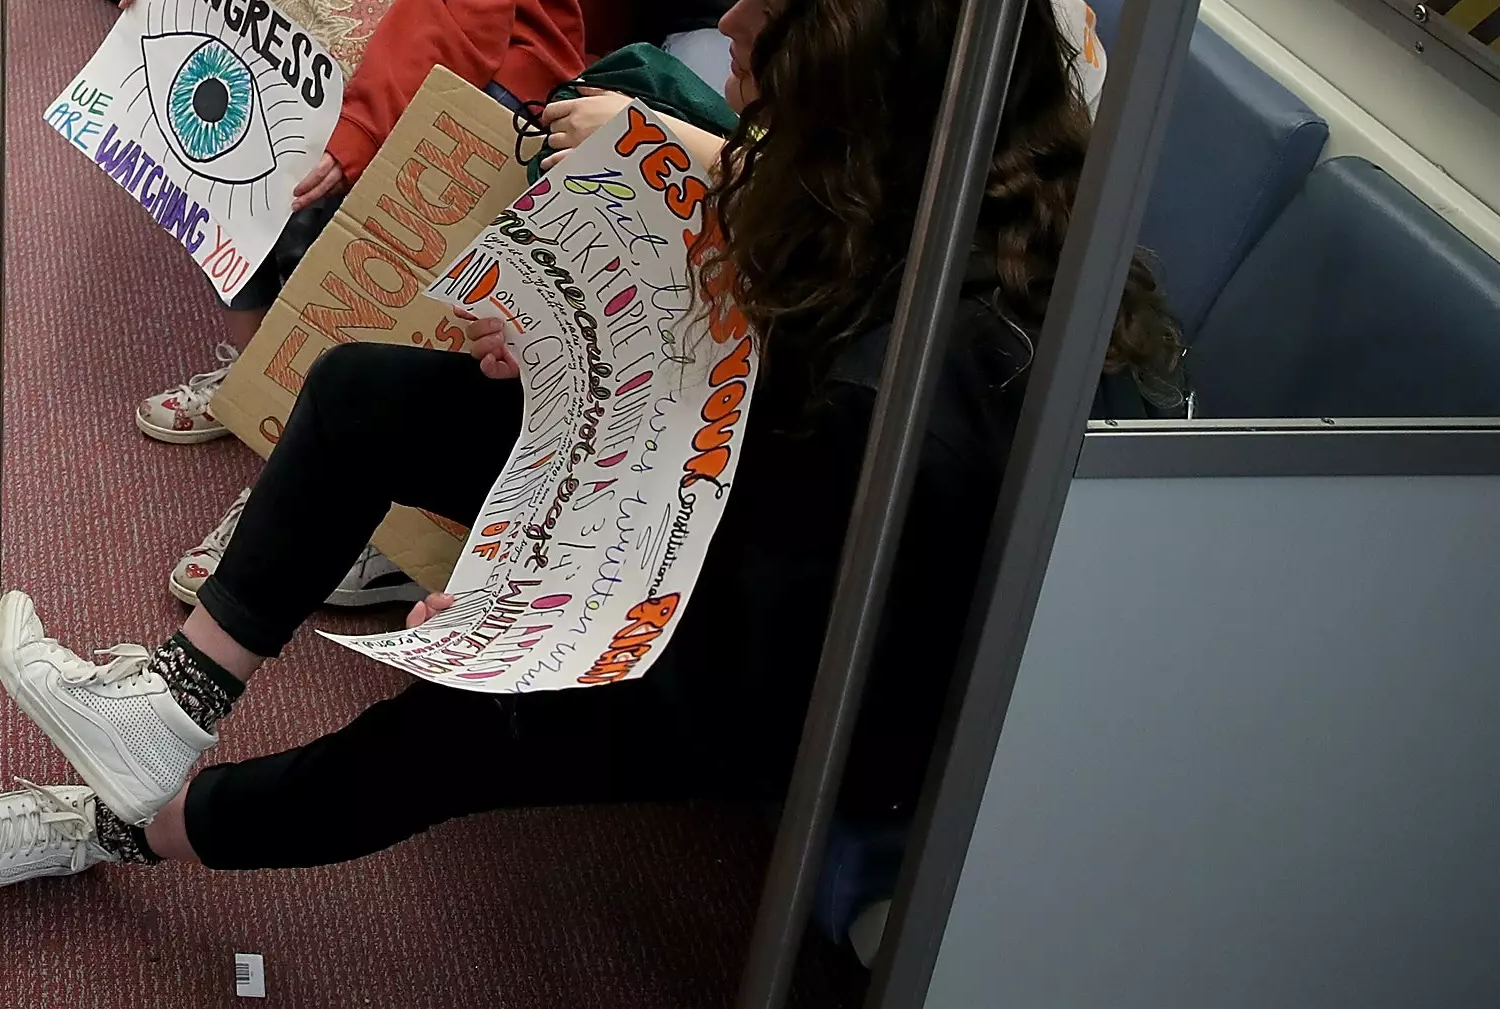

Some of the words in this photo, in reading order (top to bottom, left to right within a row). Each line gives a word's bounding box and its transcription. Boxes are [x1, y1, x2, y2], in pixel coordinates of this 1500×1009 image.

[71, 79, 114, 117] WE
[46, 103, 103, 150] ARE
[95, 123, 210, 255] WATCHING
[201, 224, 250, 294] YOU
[512, 177, 609, 274] BLACK
[264, 110, 509, 397] ENOUGH
[530, 247, 586, 312] one
[495, 290, 515, 310] oh
[587, 255, 652, 359] PEOPLE
[614, 106, 709, 220] YES
[683, 335, 753, 486] YOUR
[522, 335, 570, 434] GUNS
[594, 351, 655, 468] COUNTED
[567, 400, 605, 473] vote
[572, 477, 619, 512] AS
[472, 521, 510, 561] OF
[486, 512, 525, 585] CAPABLE
[459, 580, 543, 654] WHITE
